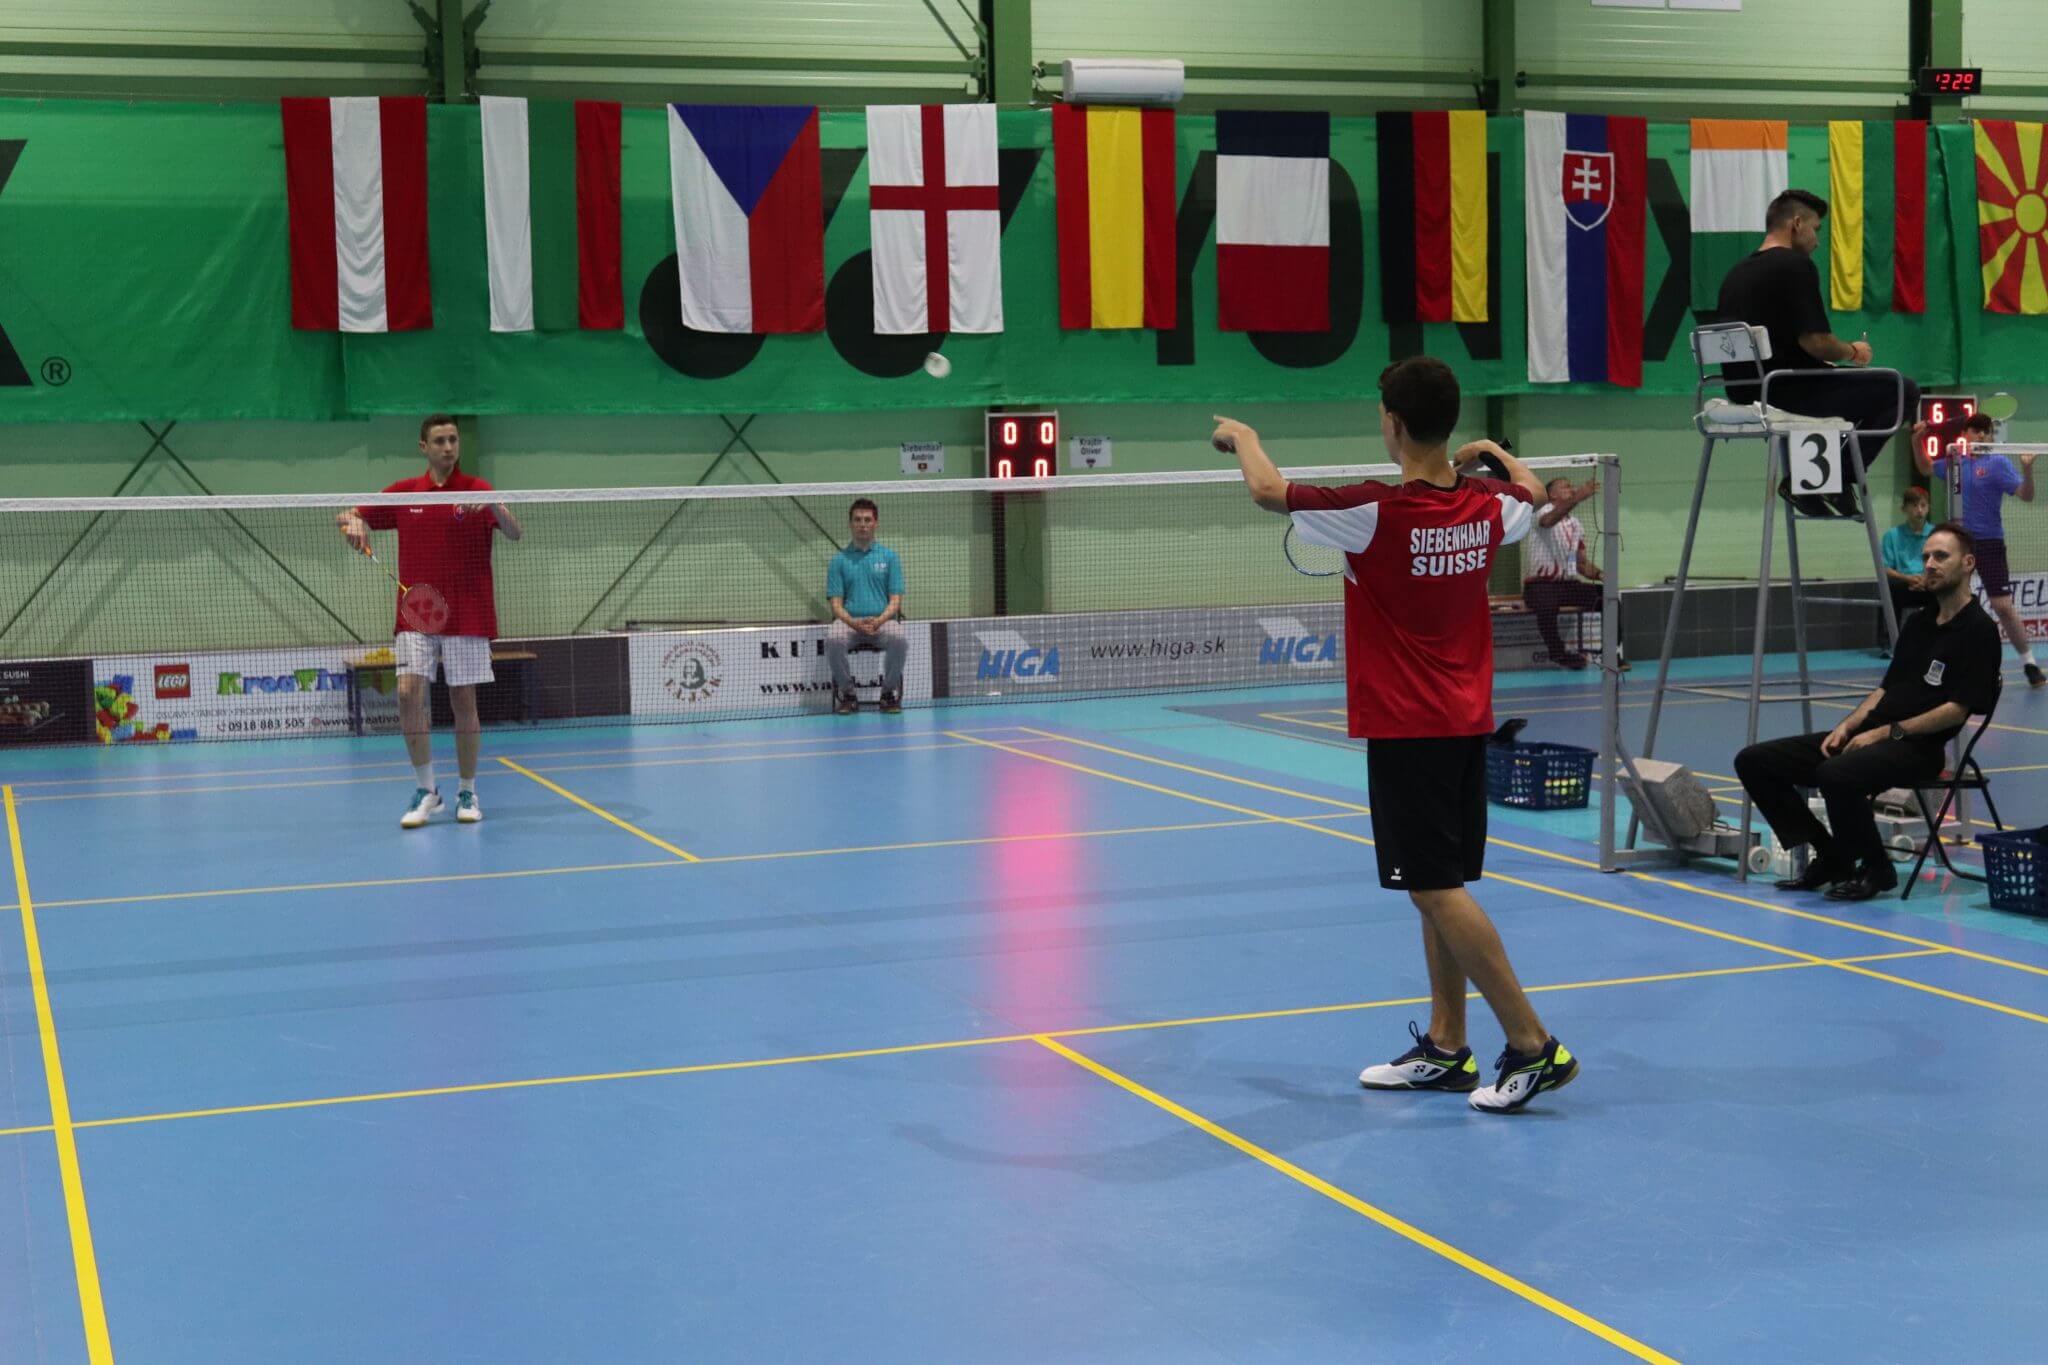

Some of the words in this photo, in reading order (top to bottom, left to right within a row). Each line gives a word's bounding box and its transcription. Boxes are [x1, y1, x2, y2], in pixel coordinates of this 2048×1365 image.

[1932, 403, 1943, 424] 6
[1004, 422, 1016, 444] 0
[1041, 422, 1054, 444] 0
[1927, 436, 1938, 457] 0
[1800, 433, 1831, 490] 3
[1410, 520, 1490, 554] SIEBENHAAR
[1411, 548, 1487, 576] SUISSE
[1091, 636, 1225, 660] www.higa.sk
[1259, 633, 1337, 665] HIGA
[3, 671, 30, 680] SUSHI
[977, 648, 1060, 680] HIGA
[158, 674, 187, 688] LEGO
[228, 720, 256, 732] 0918
[285, 717, 305, 729] 505
